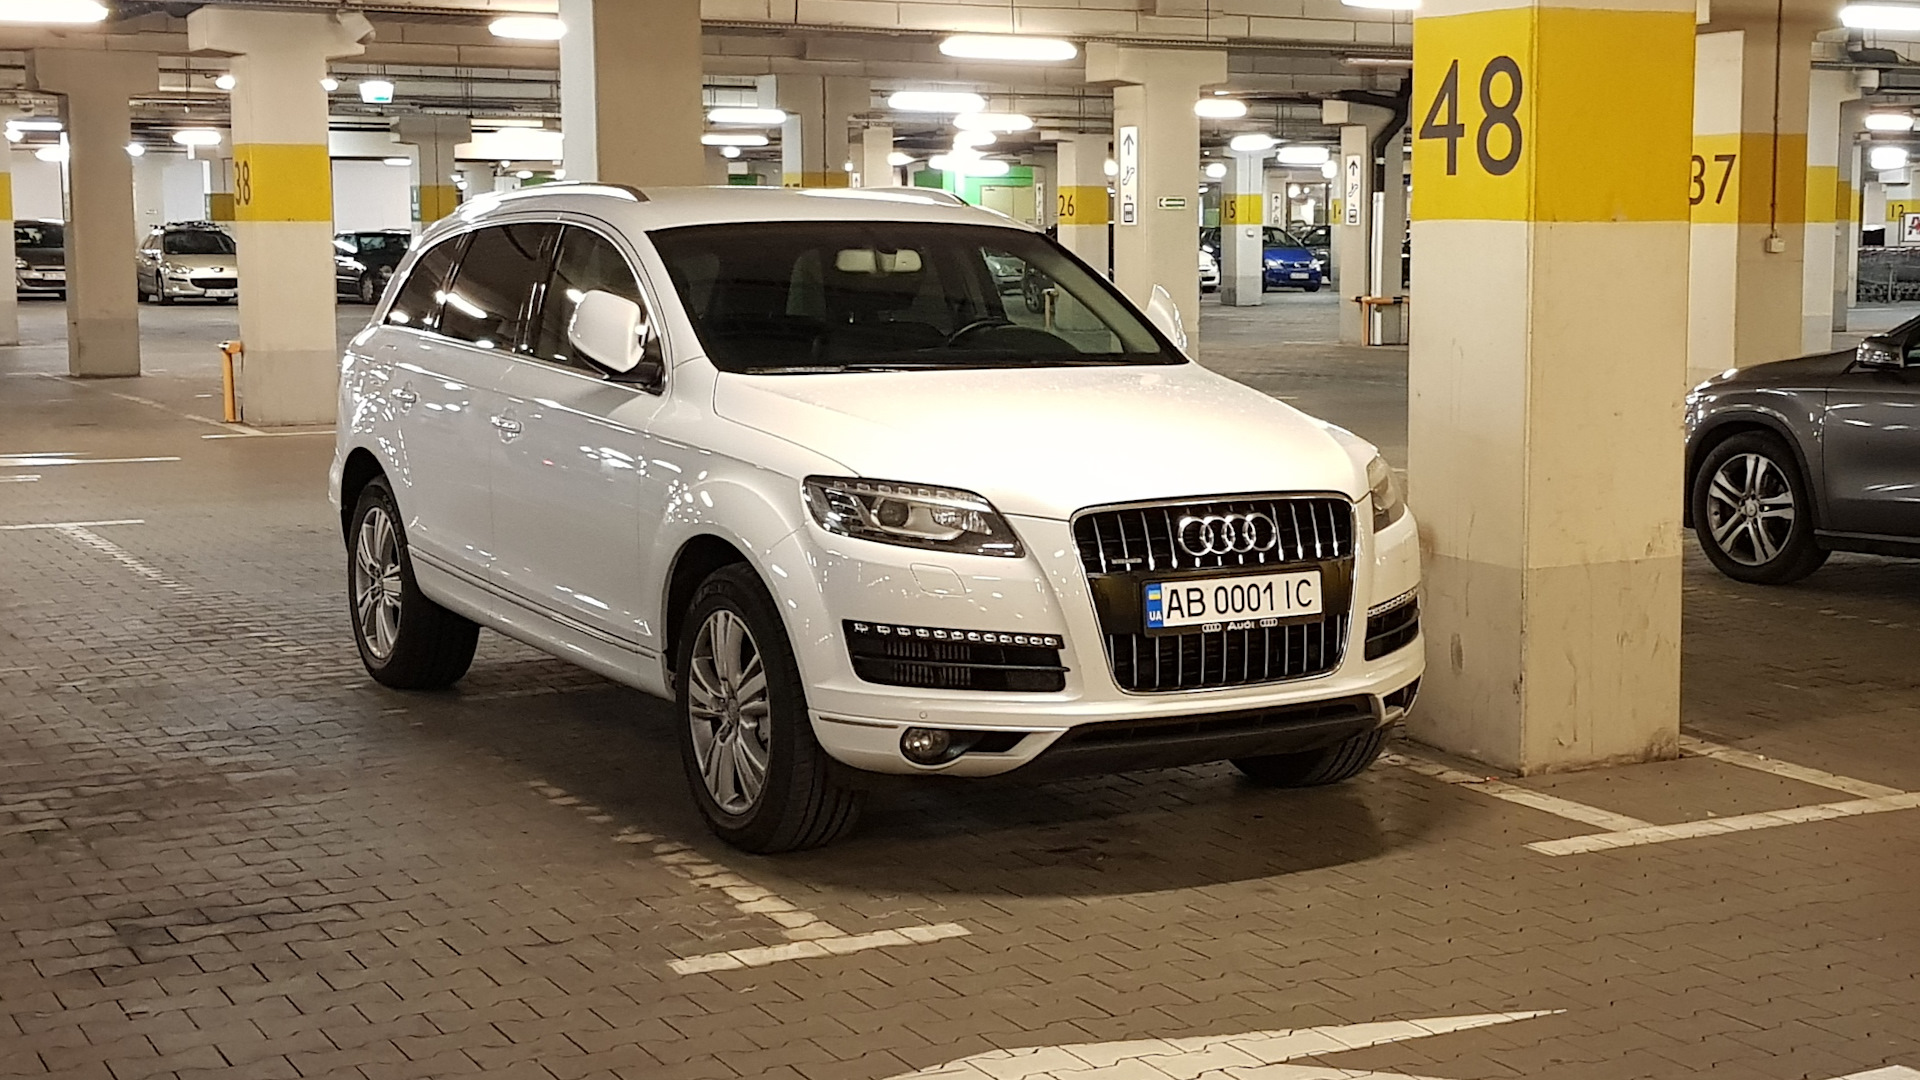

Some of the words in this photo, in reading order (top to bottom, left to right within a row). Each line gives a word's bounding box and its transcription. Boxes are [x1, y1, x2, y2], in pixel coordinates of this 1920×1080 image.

[1419, 55, 1523, 176] 48
[235, 161, 250, 206] 38
[1689, 154, 1736, 206] 37
[1059, 195, 1075, 217] 26
[1224, 200, 1236, 219] 15
[1891, 204, 1904, 218] 12
[1167, 587, 1206, 619] AB
[1214, 581, 1274, 614] 0001
[1285, 579, 1312, 609] IC
[1149, 610, 1162, 621] UA
[1227, 620, 1255, 631] Audi
